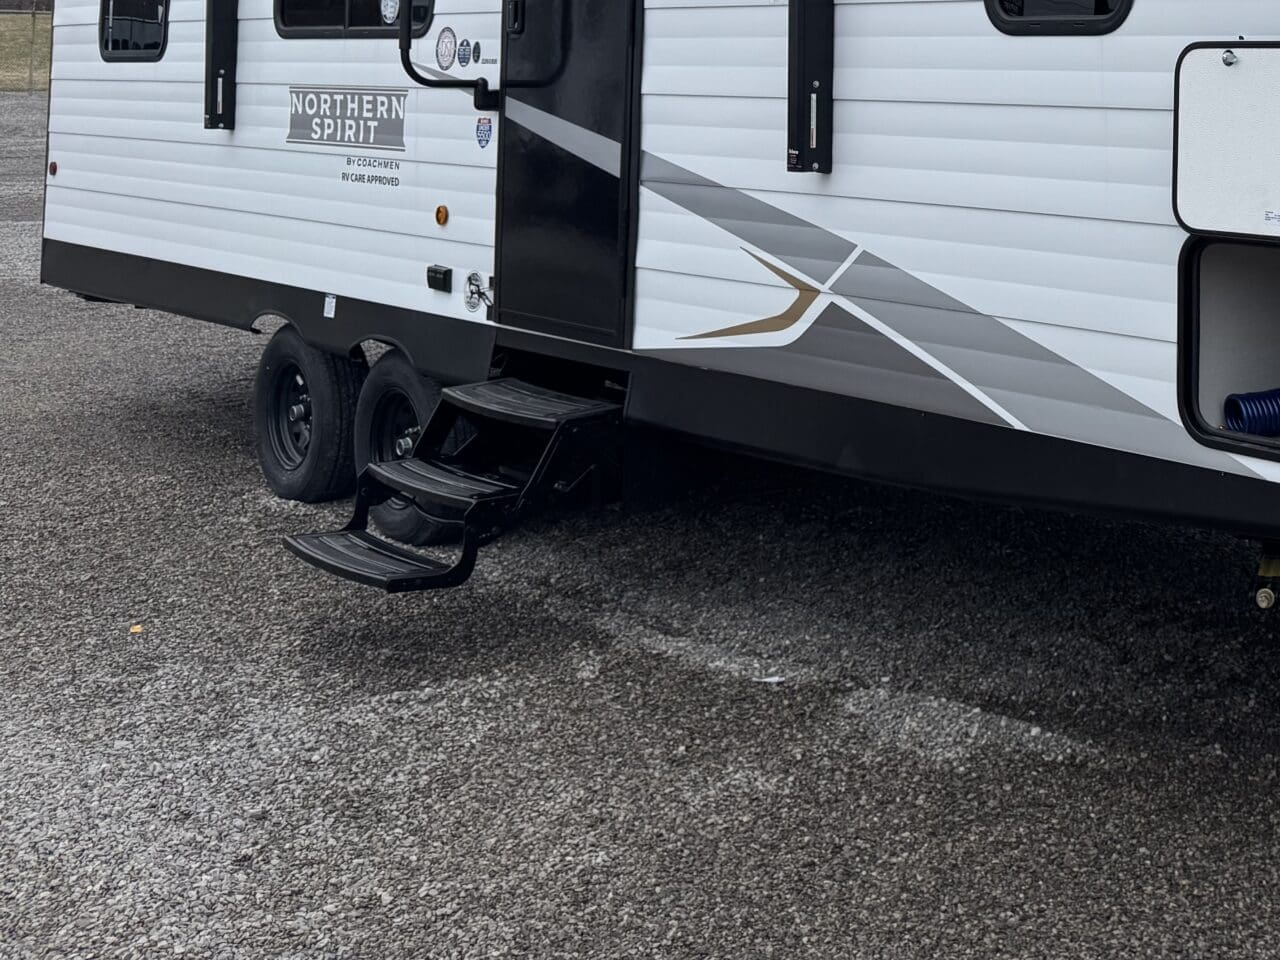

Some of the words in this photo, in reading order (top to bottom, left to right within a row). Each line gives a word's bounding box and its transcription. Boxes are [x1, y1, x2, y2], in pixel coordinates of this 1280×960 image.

[290, 92, 405, 119] NORTHERN
[311, 118, 378, 143] SPIRIT
[357, 158, 400, 170] COACHMEN
[341, 172, 350, 182] RV
[351, 173, 366, 183] CARE
[367, 174, 400, 186] APPROVED
